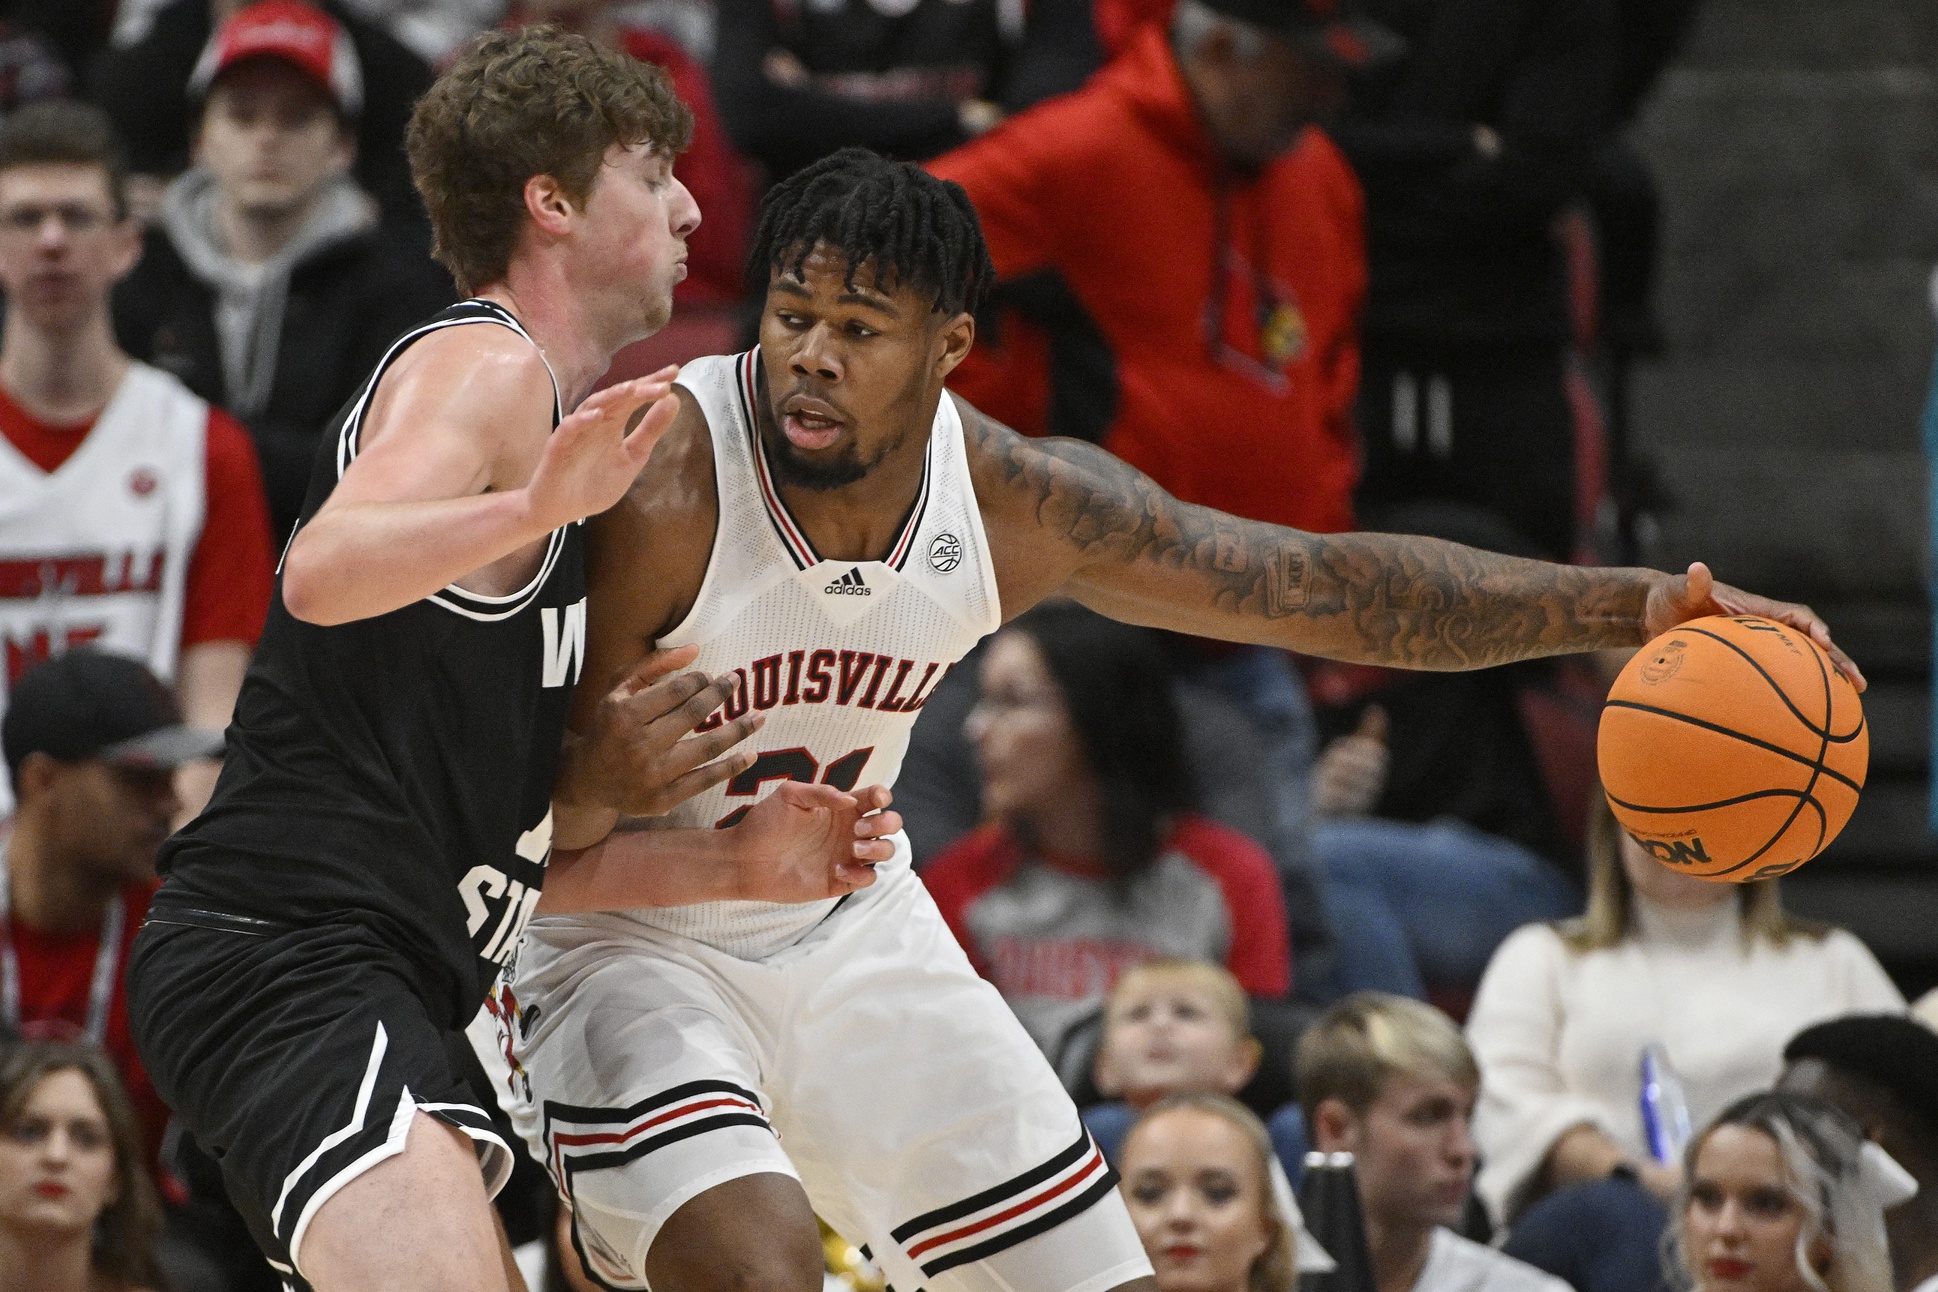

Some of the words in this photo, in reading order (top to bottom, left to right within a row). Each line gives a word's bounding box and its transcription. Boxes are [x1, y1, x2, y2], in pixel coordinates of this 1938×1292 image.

[933, 544, 961, 556] ACC
[824, 584, 872, 596] adidas
[693, 648, 957, 734] OUISVILL
